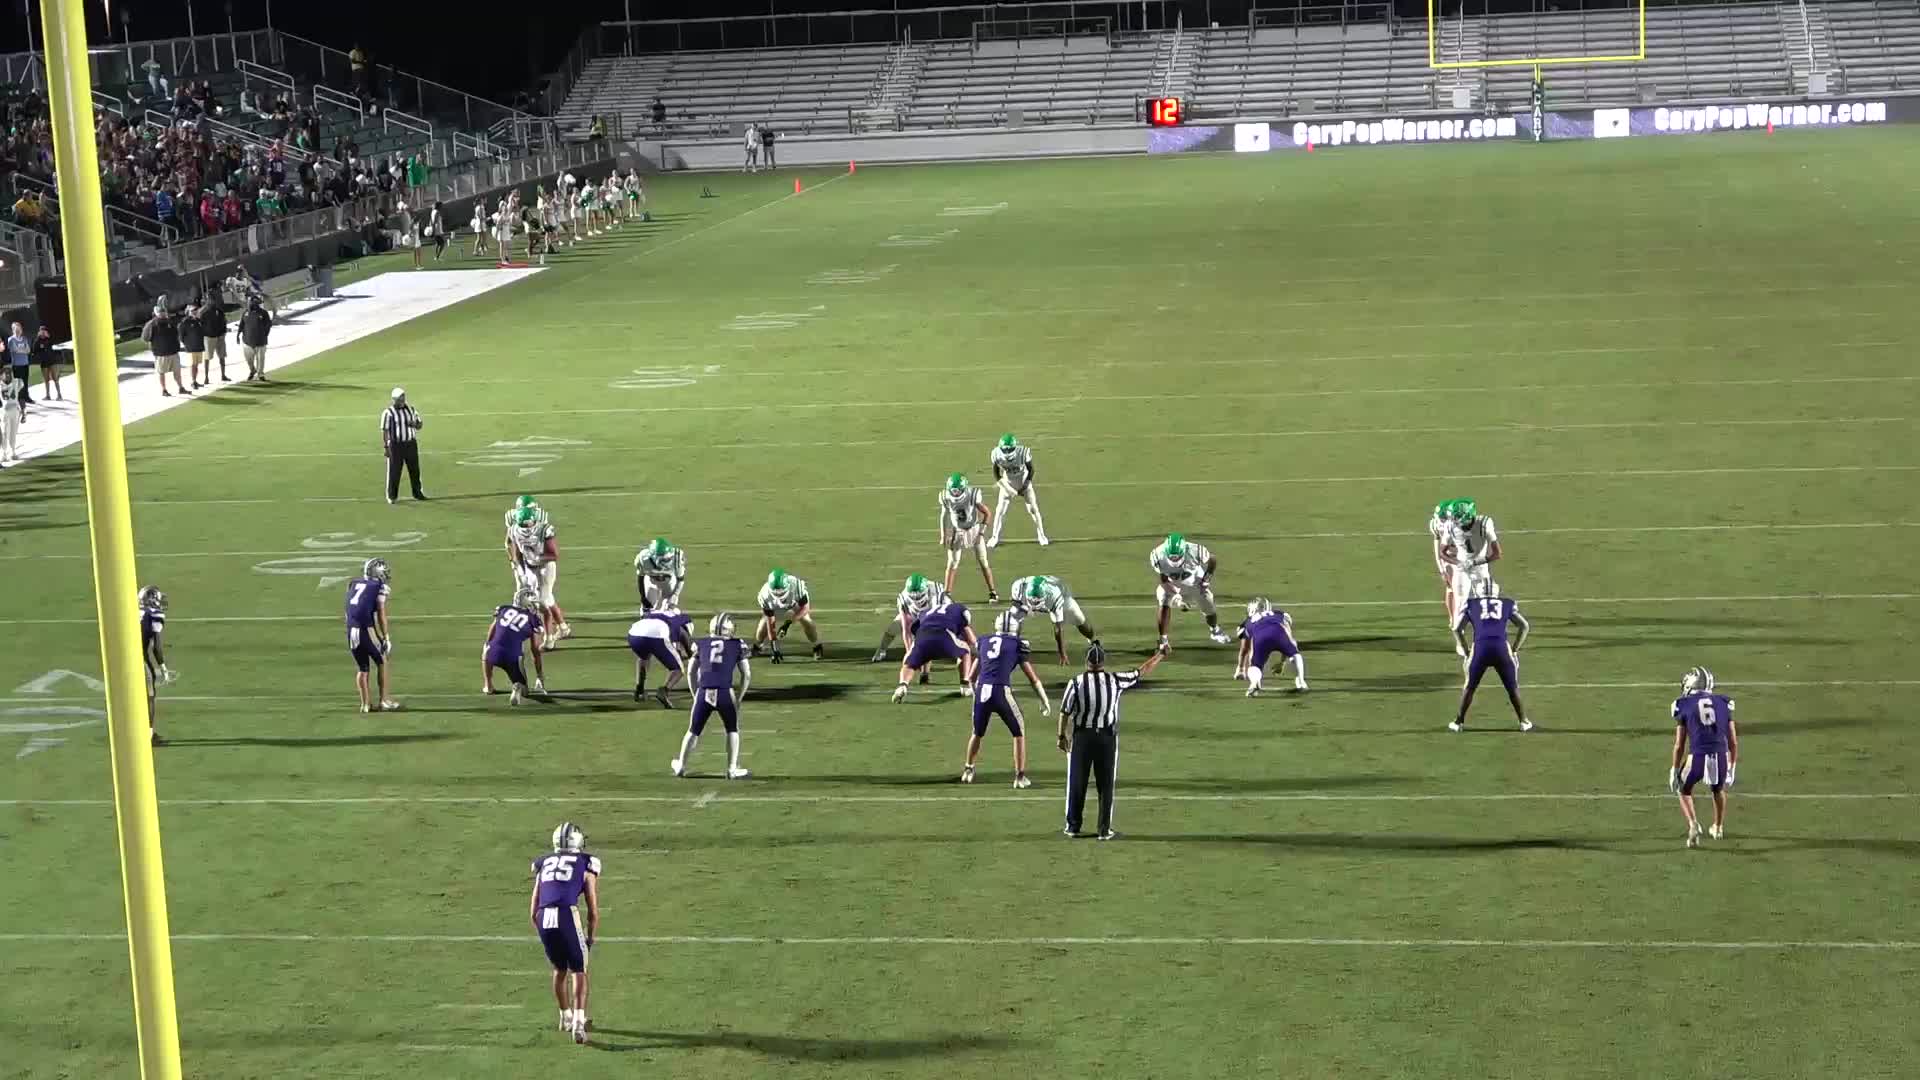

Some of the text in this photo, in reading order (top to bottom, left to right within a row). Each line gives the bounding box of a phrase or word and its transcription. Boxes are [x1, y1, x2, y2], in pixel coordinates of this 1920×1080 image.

[1154, 98, 1178, 121] 12
[1655, 102, 1887, 131] CaryPopWarner.com
[1293, 118, 1516, 146] CaryPopWarner.com
[350, 583, 367, 605] 7
[500, 609, 528, 632] 90
[1480, 599, 1503, 620] 13
[710, 640, 724, 663] 2
[987, 636, 1002, 659] 3
[1698, 698, 1716, 726] 6
[541, 856, 577, 883] 25
